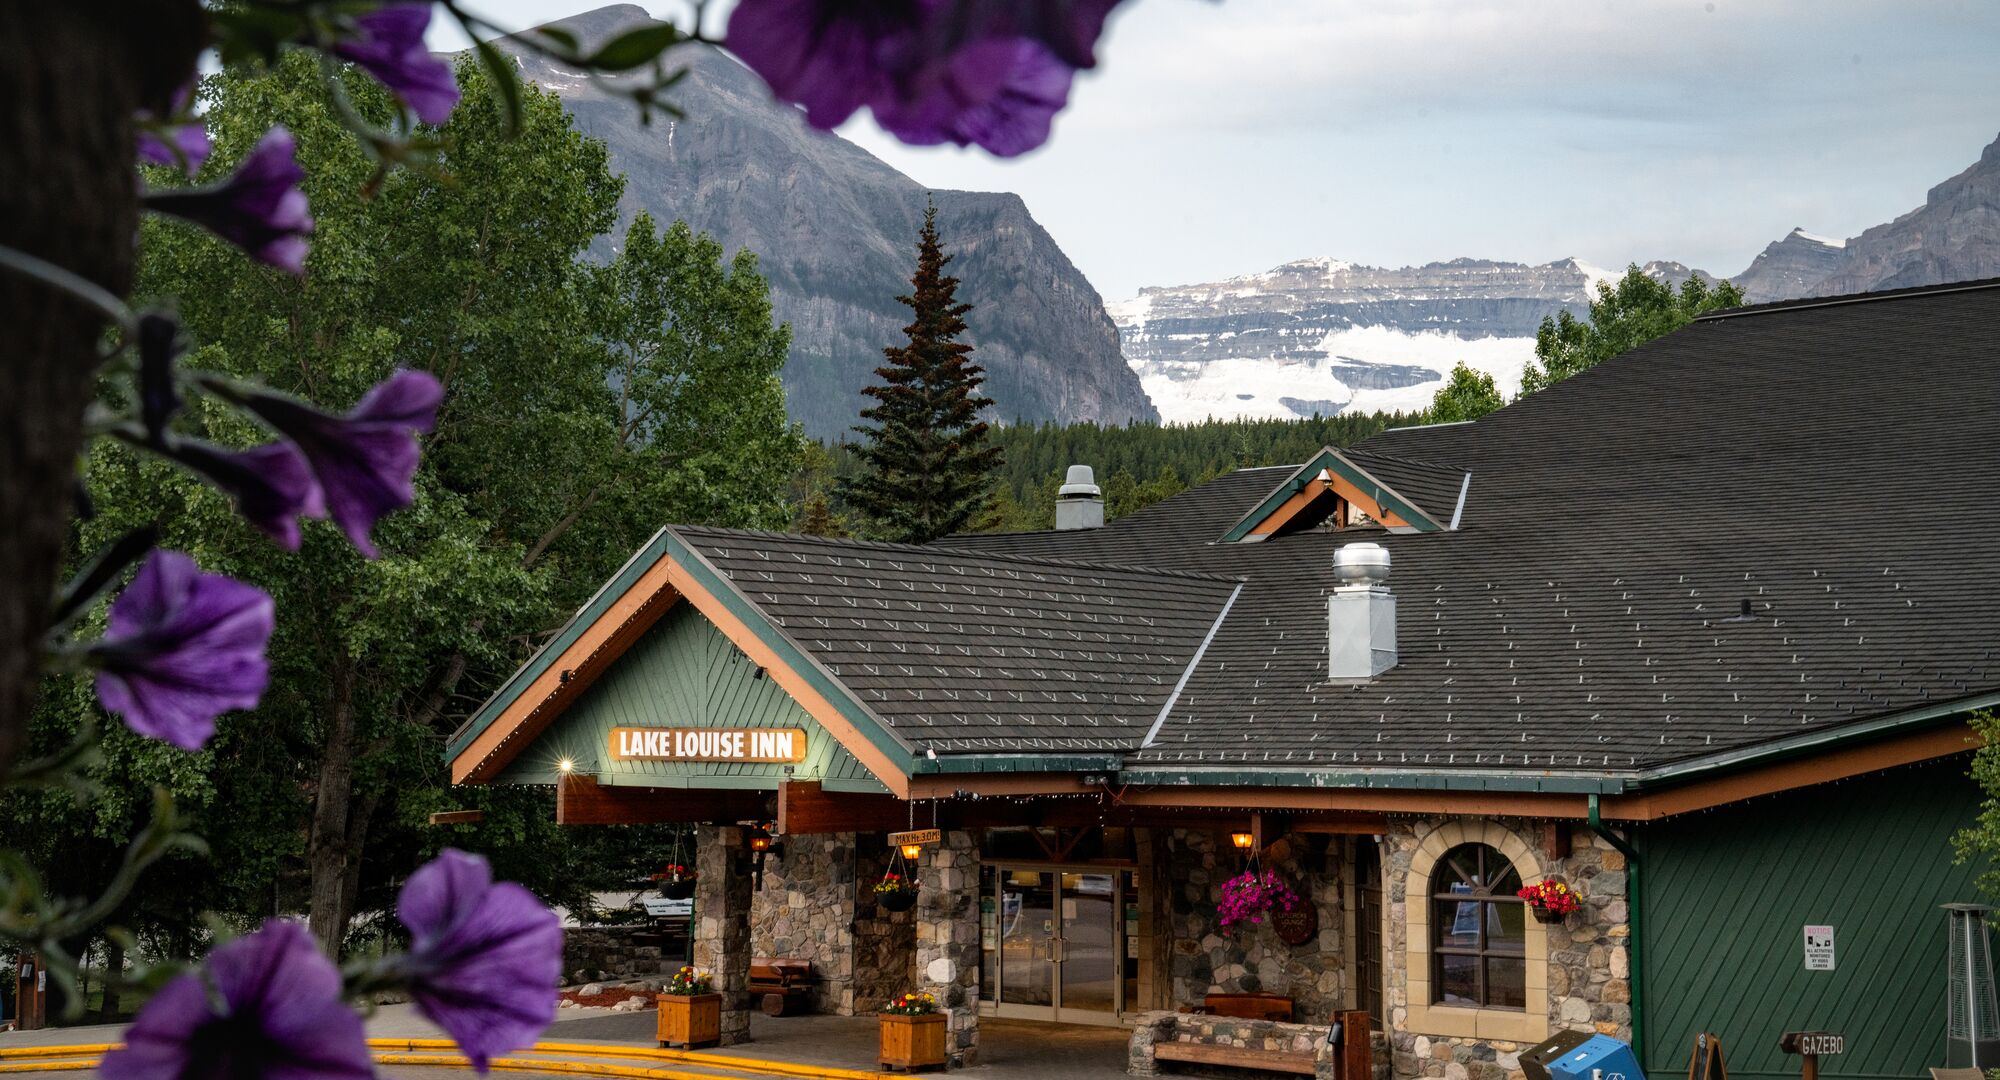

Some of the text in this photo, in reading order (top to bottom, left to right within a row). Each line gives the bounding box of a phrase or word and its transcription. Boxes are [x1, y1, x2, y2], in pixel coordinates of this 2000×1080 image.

[619, 731, 793, 759] LAKE LOUISE INN
[896, 833, 911, 845] MAX
[1802, 1036, 1844, 1055] GAZEBO
